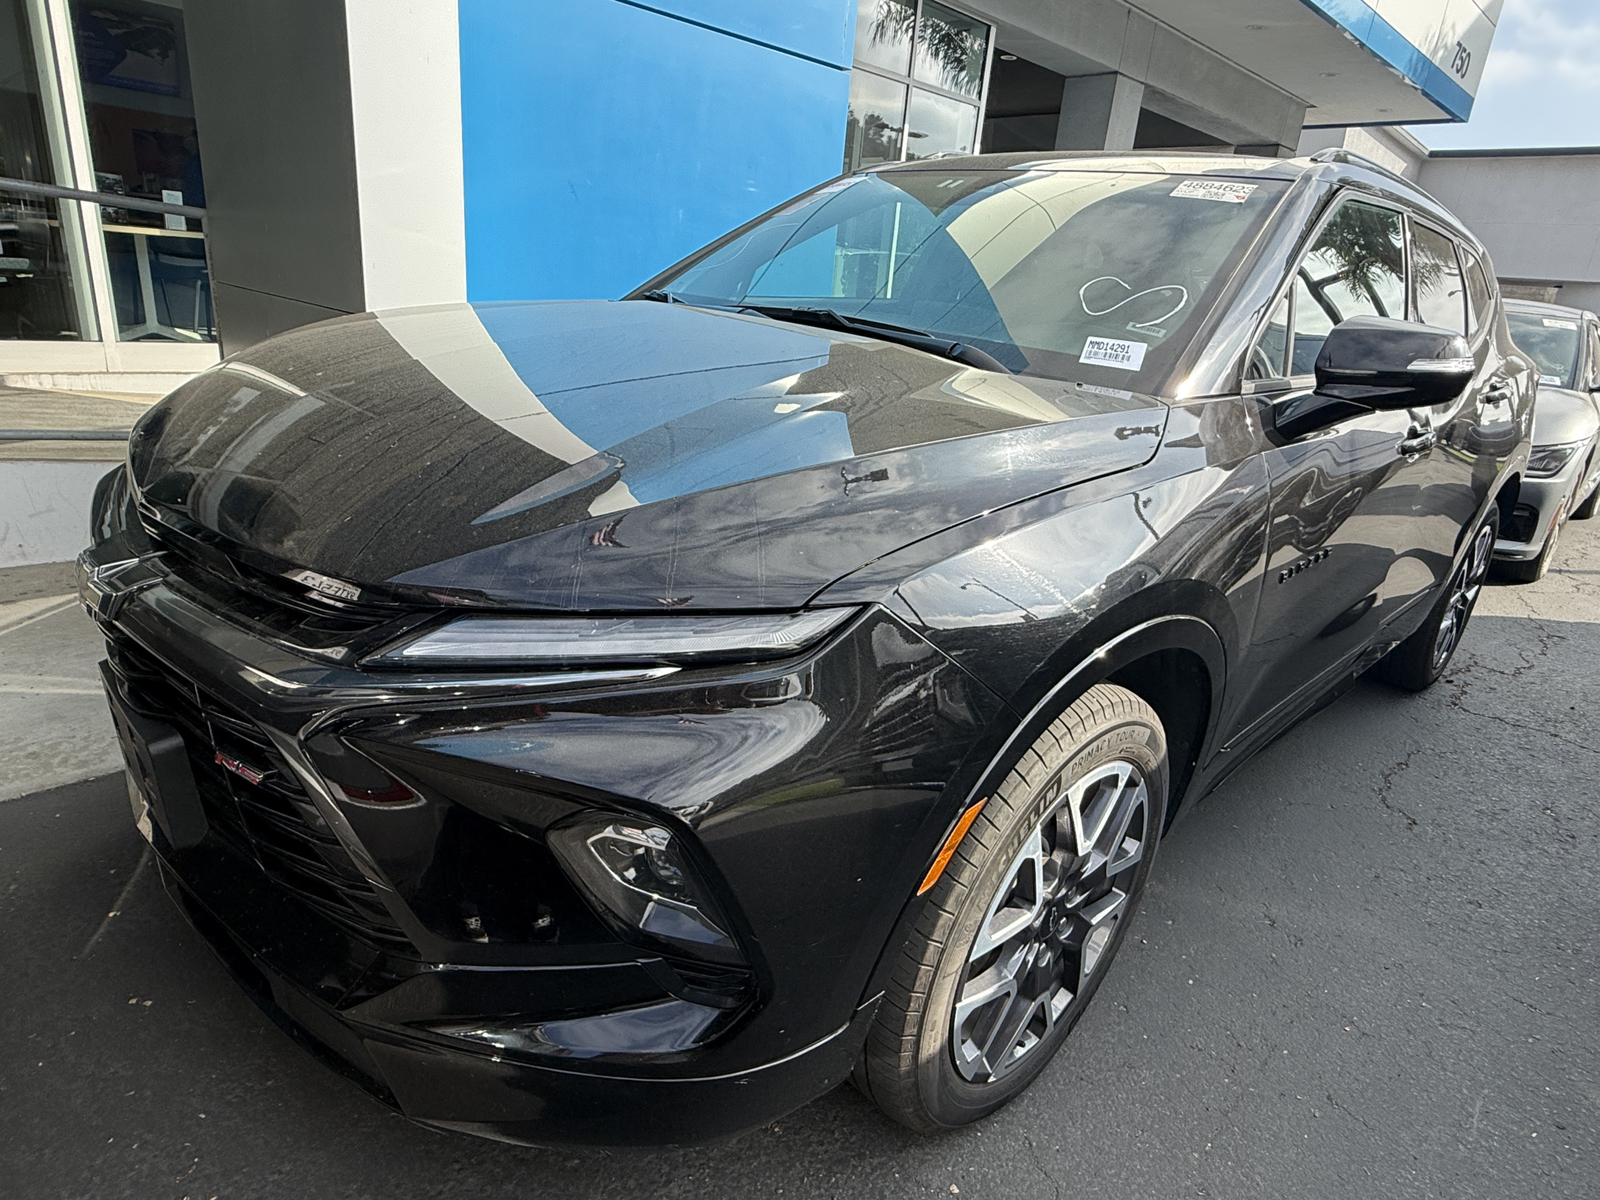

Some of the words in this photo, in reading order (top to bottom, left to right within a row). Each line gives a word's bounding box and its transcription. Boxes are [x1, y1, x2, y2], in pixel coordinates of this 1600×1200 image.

[1451, 40, 1471, 79] 750
[1087, 340, 1131, 354] MMD14291
[1071, 736, 1113, 775] PRIMACY
[1115, 729, 1136, 743] TOUR
